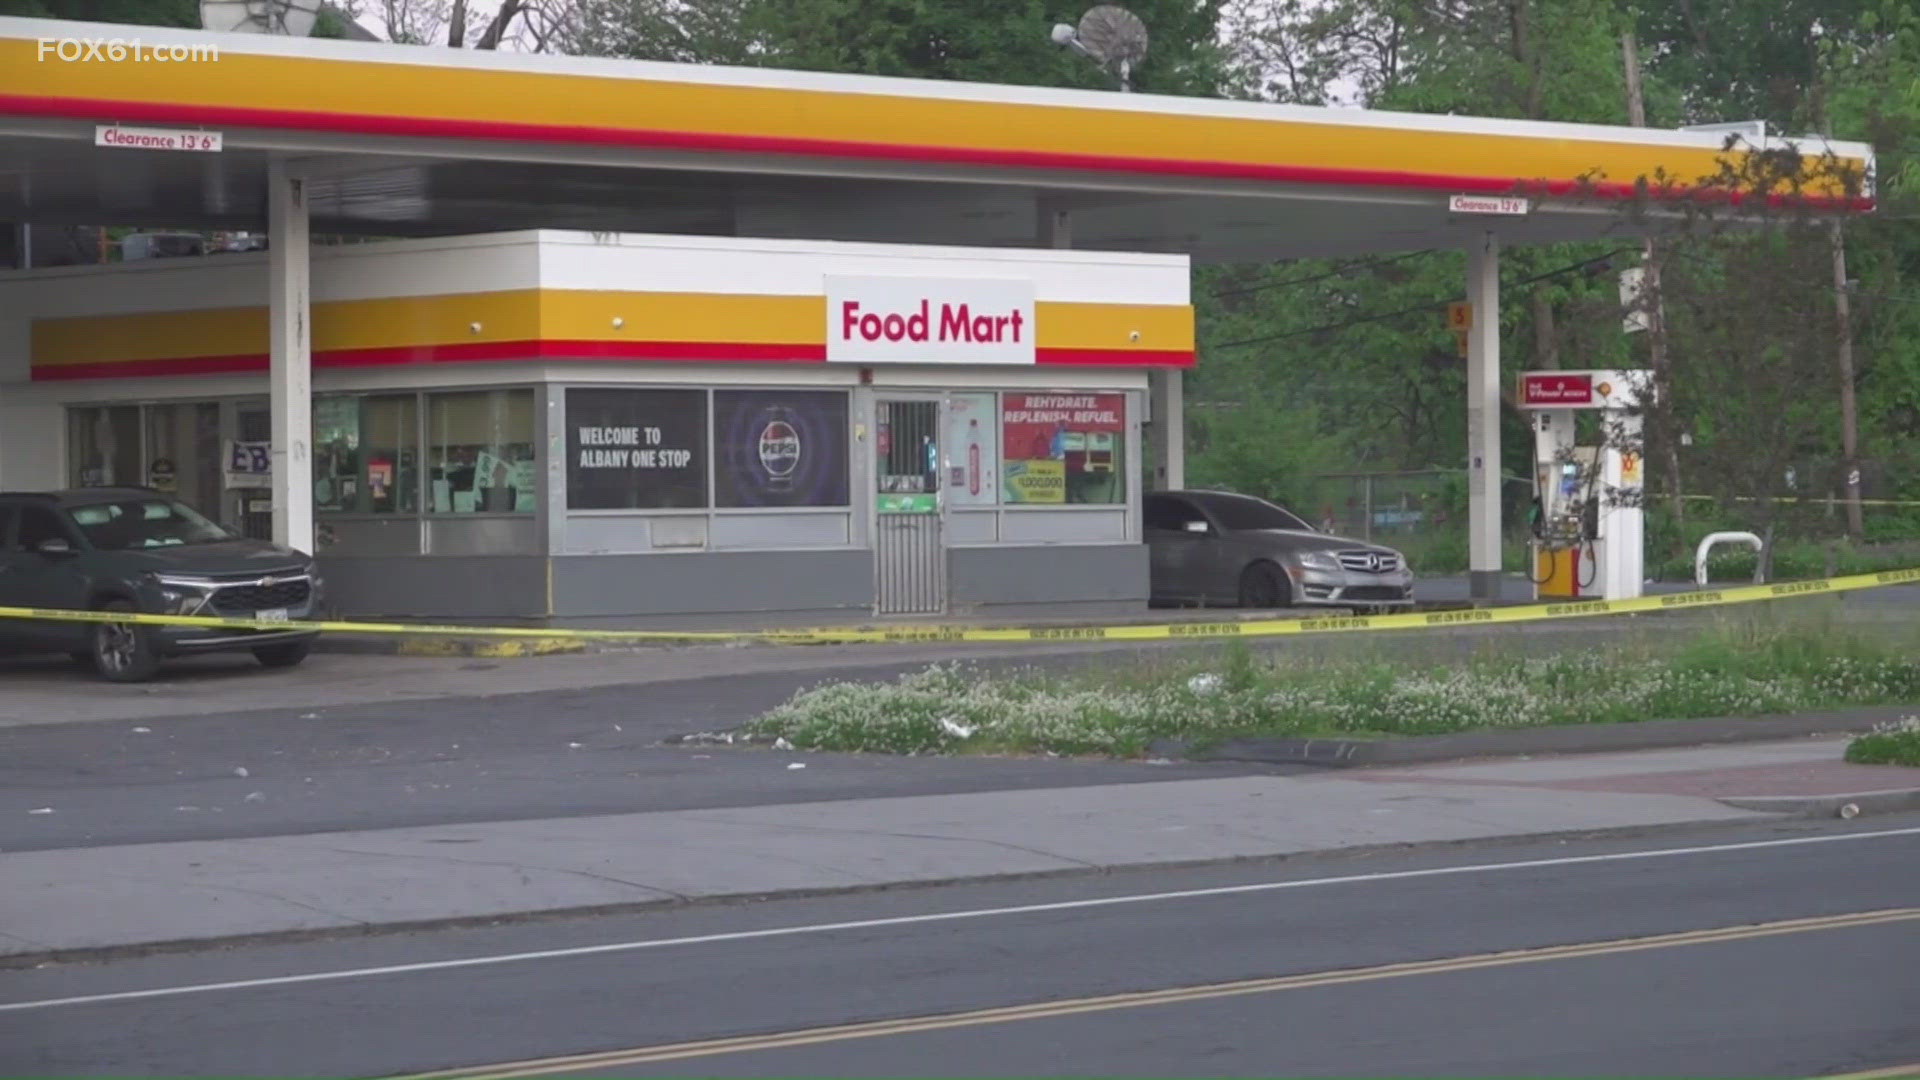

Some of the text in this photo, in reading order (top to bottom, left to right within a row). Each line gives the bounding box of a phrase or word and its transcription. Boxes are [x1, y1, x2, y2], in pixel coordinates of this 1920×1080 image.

[104, 129, 175, 148] Clearance
[1455, 196, 1498, 210] Clearance
[843, 299, 1024, 343] Food Mart
[1025, 396, 1098, 409] REHYDRATE.
[1073, 411, 1118, 423] REFUEL.
[579, 427, 661, 445] WELCOME TO
[761, 442, 798, 455] PEPSI
[580, 449, 691, 468] ALBANY ONE STOP
